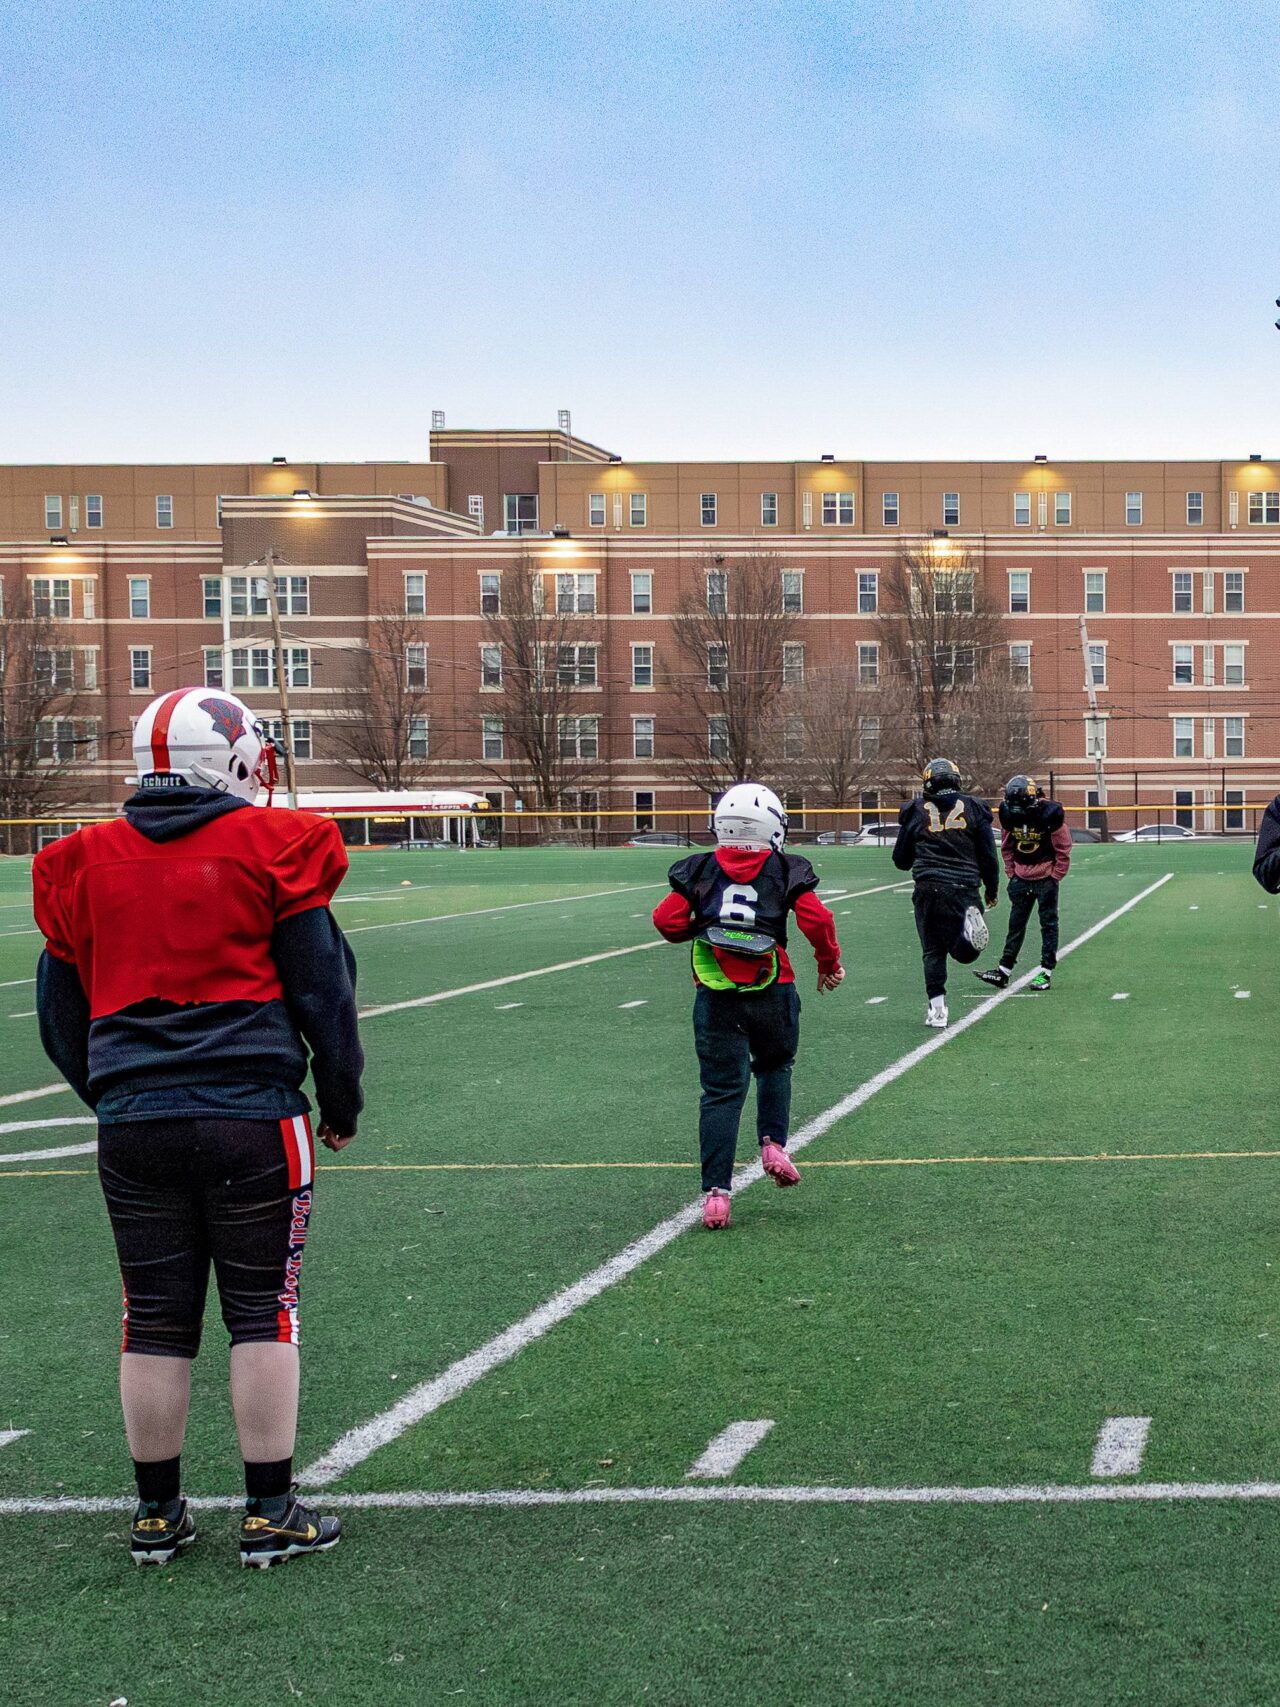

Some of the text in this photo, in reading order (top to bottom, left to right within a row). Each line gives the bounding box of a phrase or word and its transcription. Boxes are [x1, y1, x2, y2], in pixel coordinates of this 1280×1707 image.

[143, 775, 181, 787] schutt
[719, 883, 758, 926] 6
[289, 1190, 312, 1248] Bell
